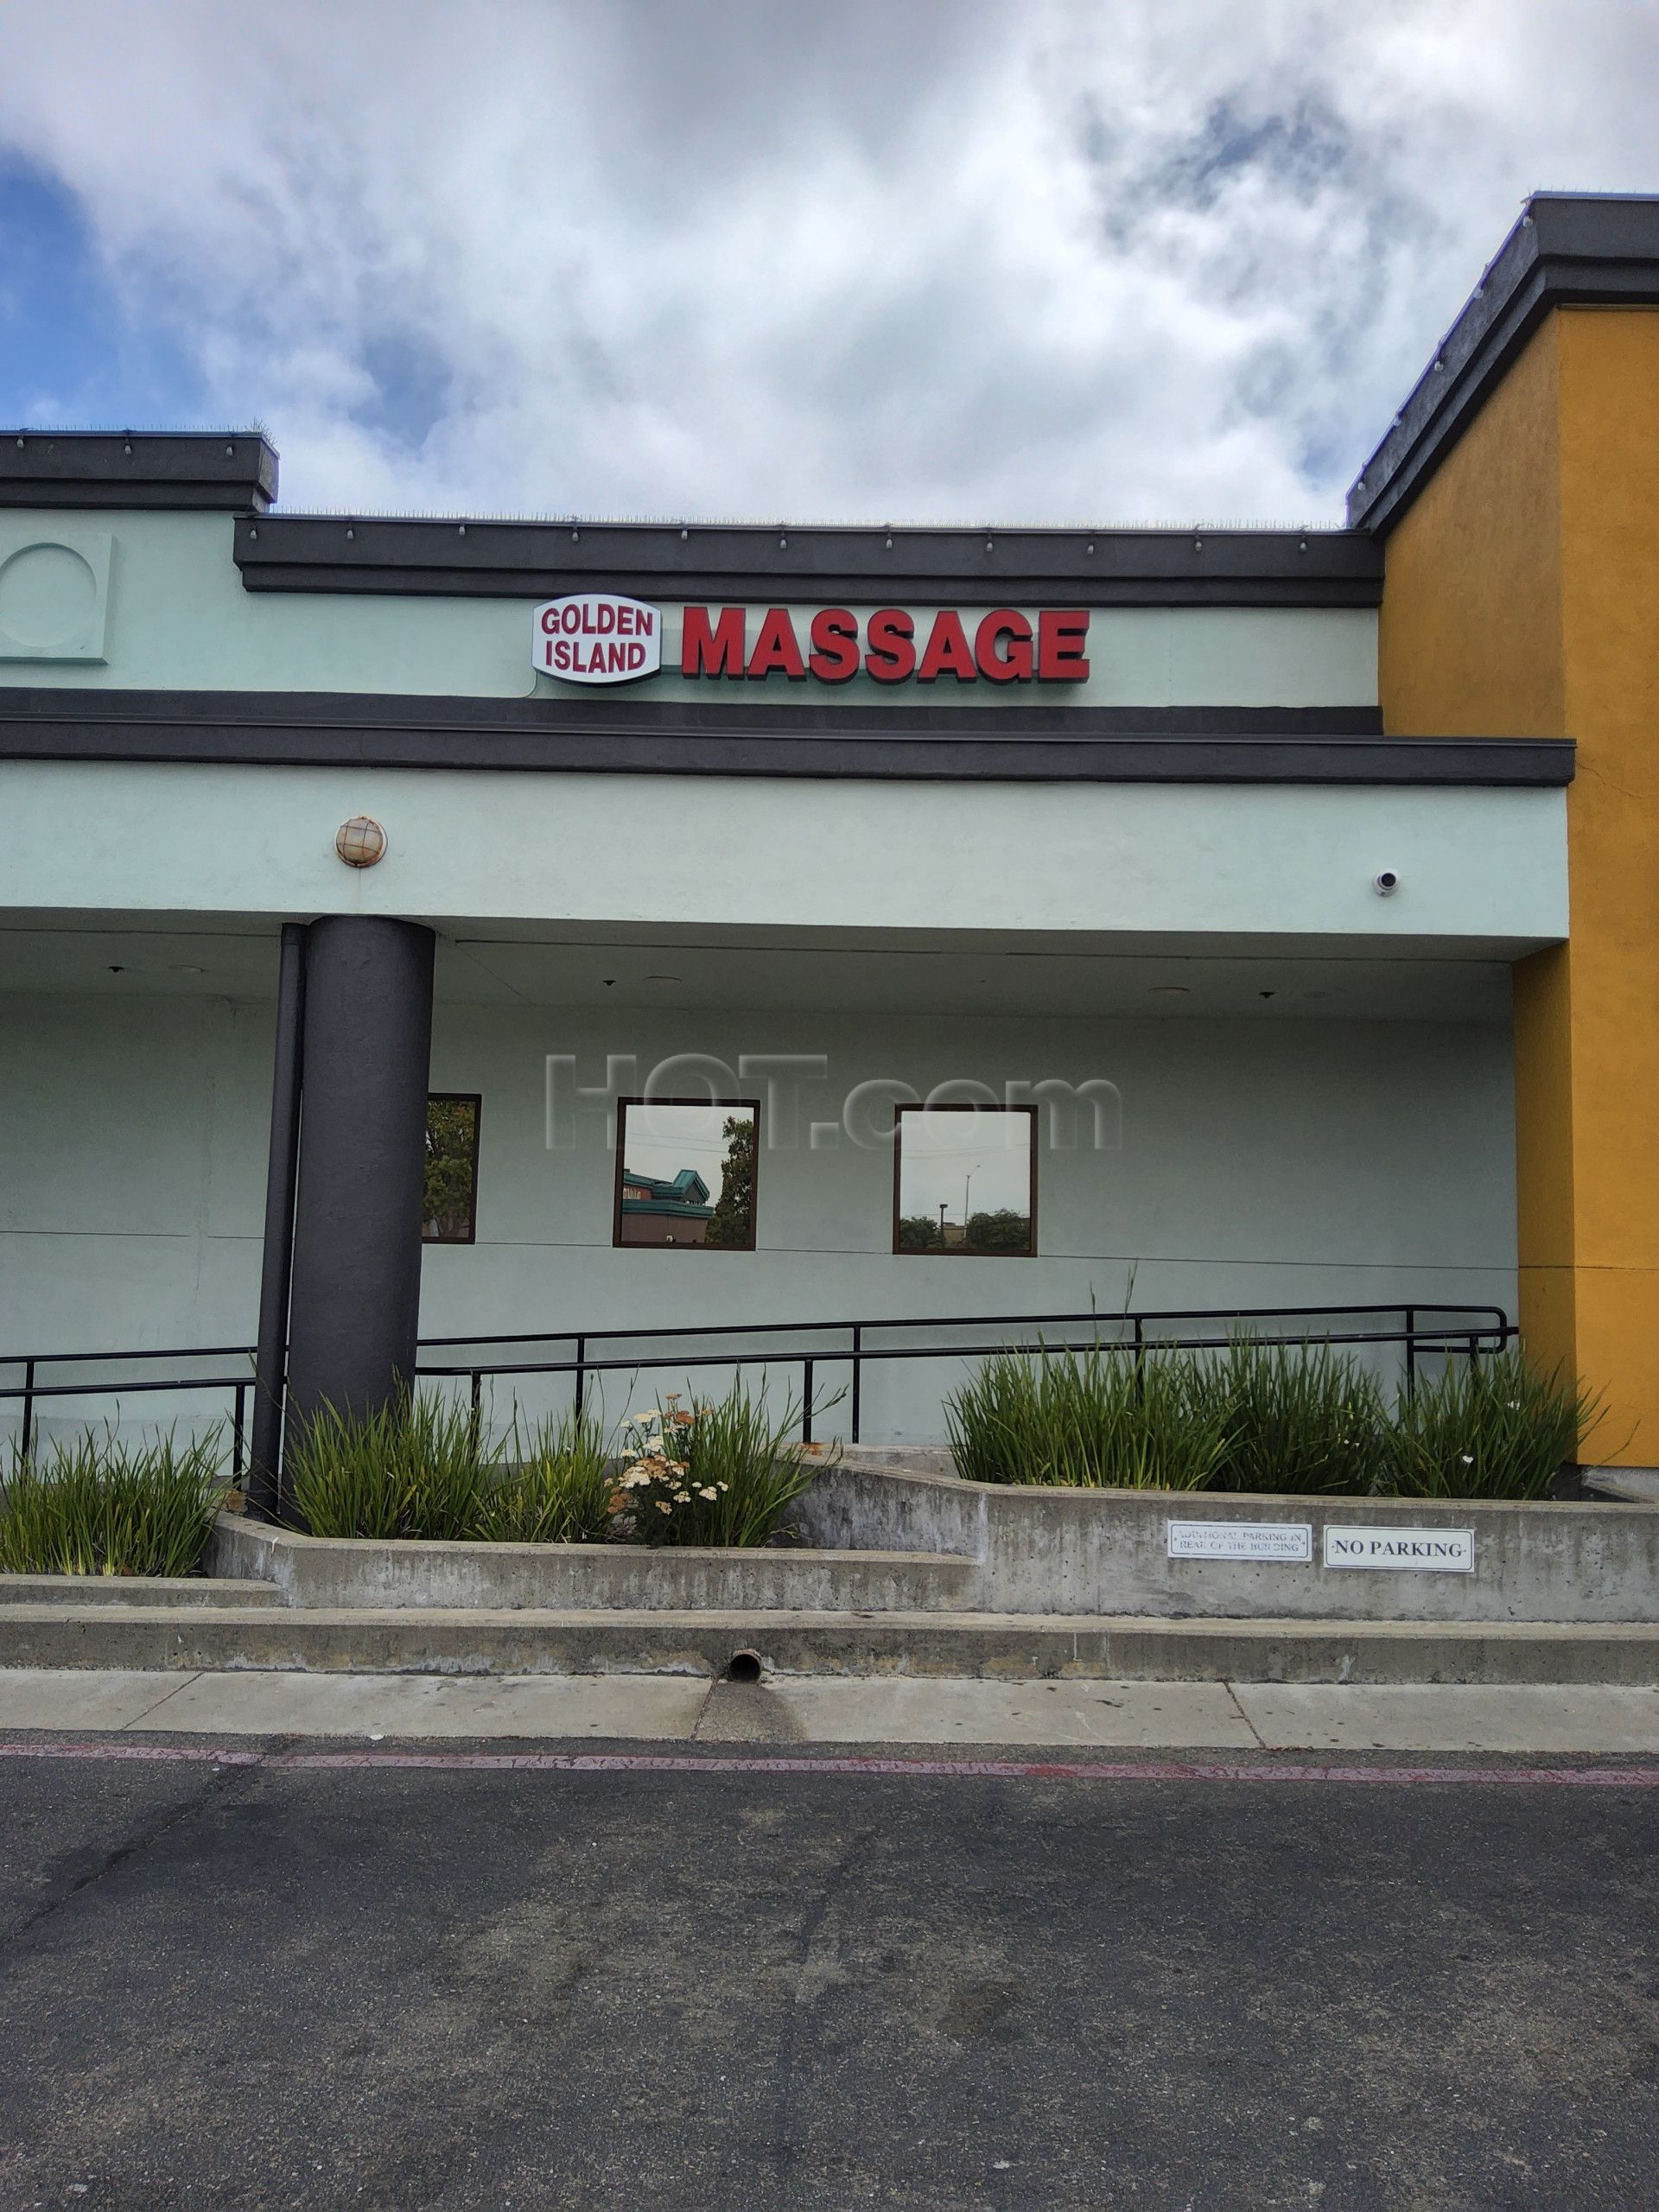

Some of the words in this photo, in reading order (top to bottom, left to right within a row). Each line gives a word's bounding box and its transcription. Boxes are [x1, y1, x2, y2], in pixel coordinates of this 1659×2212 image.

[541, 603, 653, 637] GOLDEN
[545, 640, 646, 674] ISLAND
[681, 606, 1090, 685] MASSAGE
[1180, 1530, 1237, 1540] DDITIONA
[1243, 1532, 1287, 1541] PARKING
[1334, 1540, 1364, 1555] NO
[1370, 1541, 1462, 1558] PARKING
